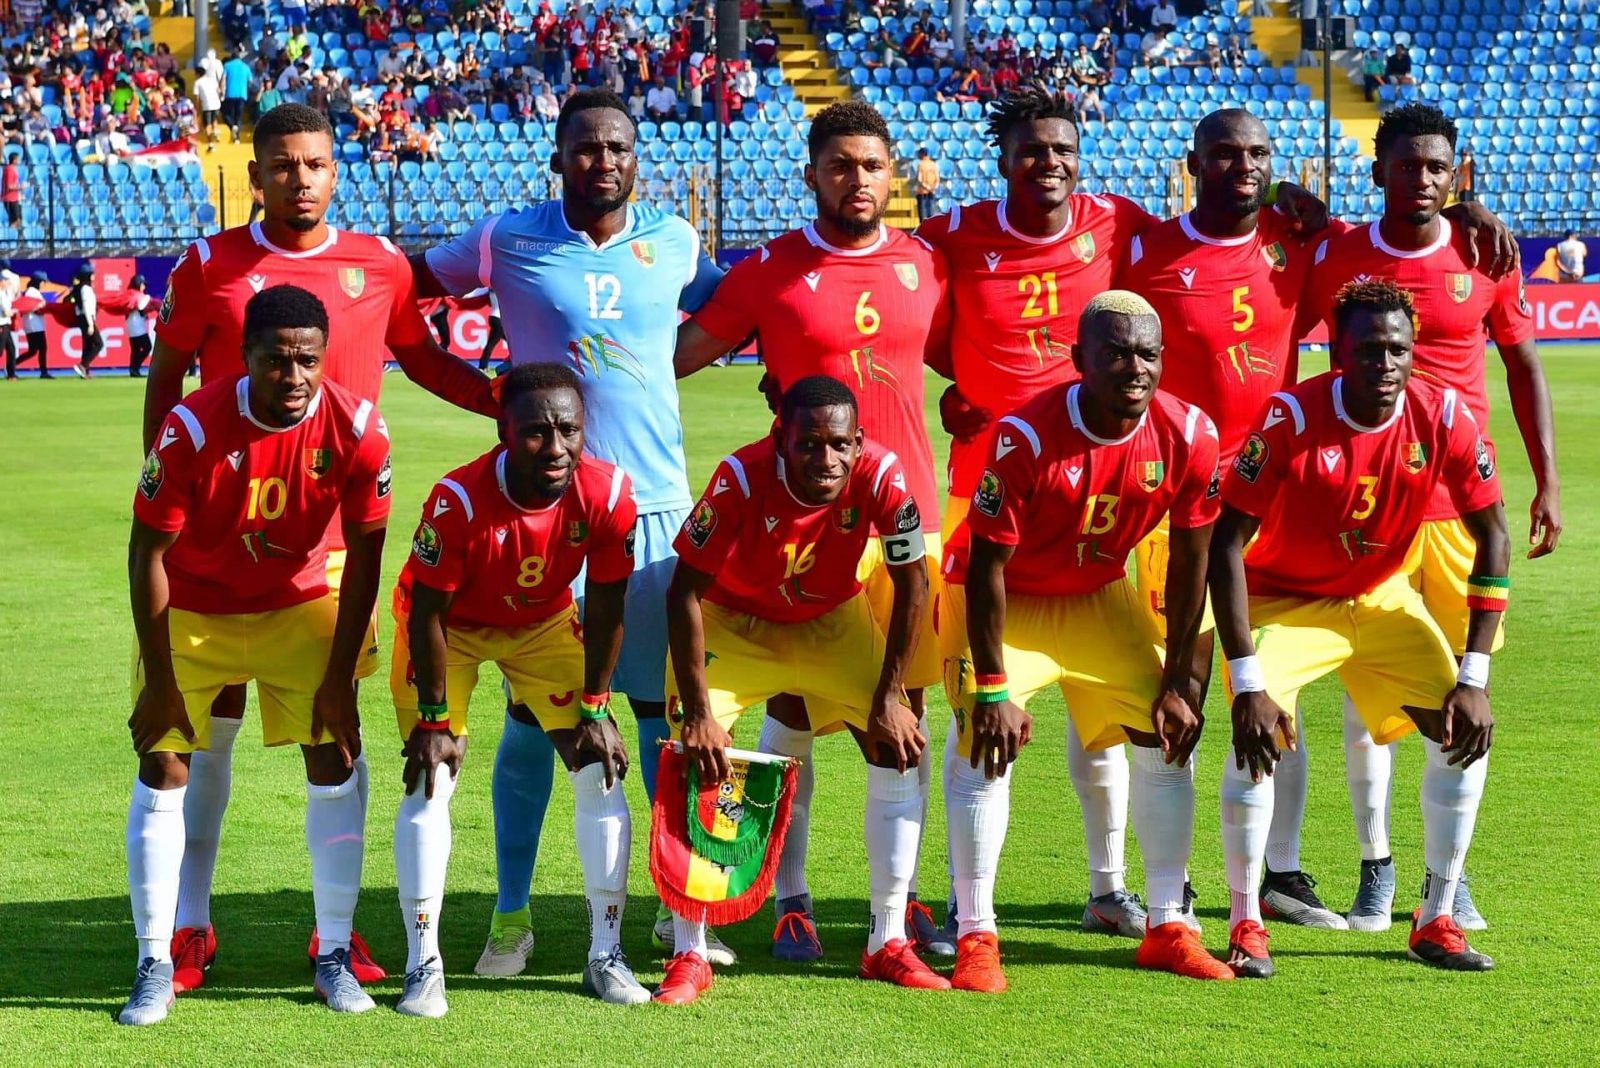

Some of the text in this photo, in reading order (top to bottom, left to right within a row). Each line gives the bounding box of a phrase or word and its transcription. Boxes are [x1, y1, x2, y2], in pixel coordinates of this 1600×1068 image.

[584, 273, 624, 320] 12
[854, 291, 881, 336] 6
[1018, 272, 1059, 319] 21
[1232, 285, 1255, 333] 5
[1526, 300, 1600, 330] ICA
[247, 477, 288, 521] 10
[1081, 494, 1121, 536] 13
[1351, 475, 1379, 521] 3
[516, 556, 546, 588] 8
[783, 542, 816, 580] 16
[885, 539, 911, 562] C
